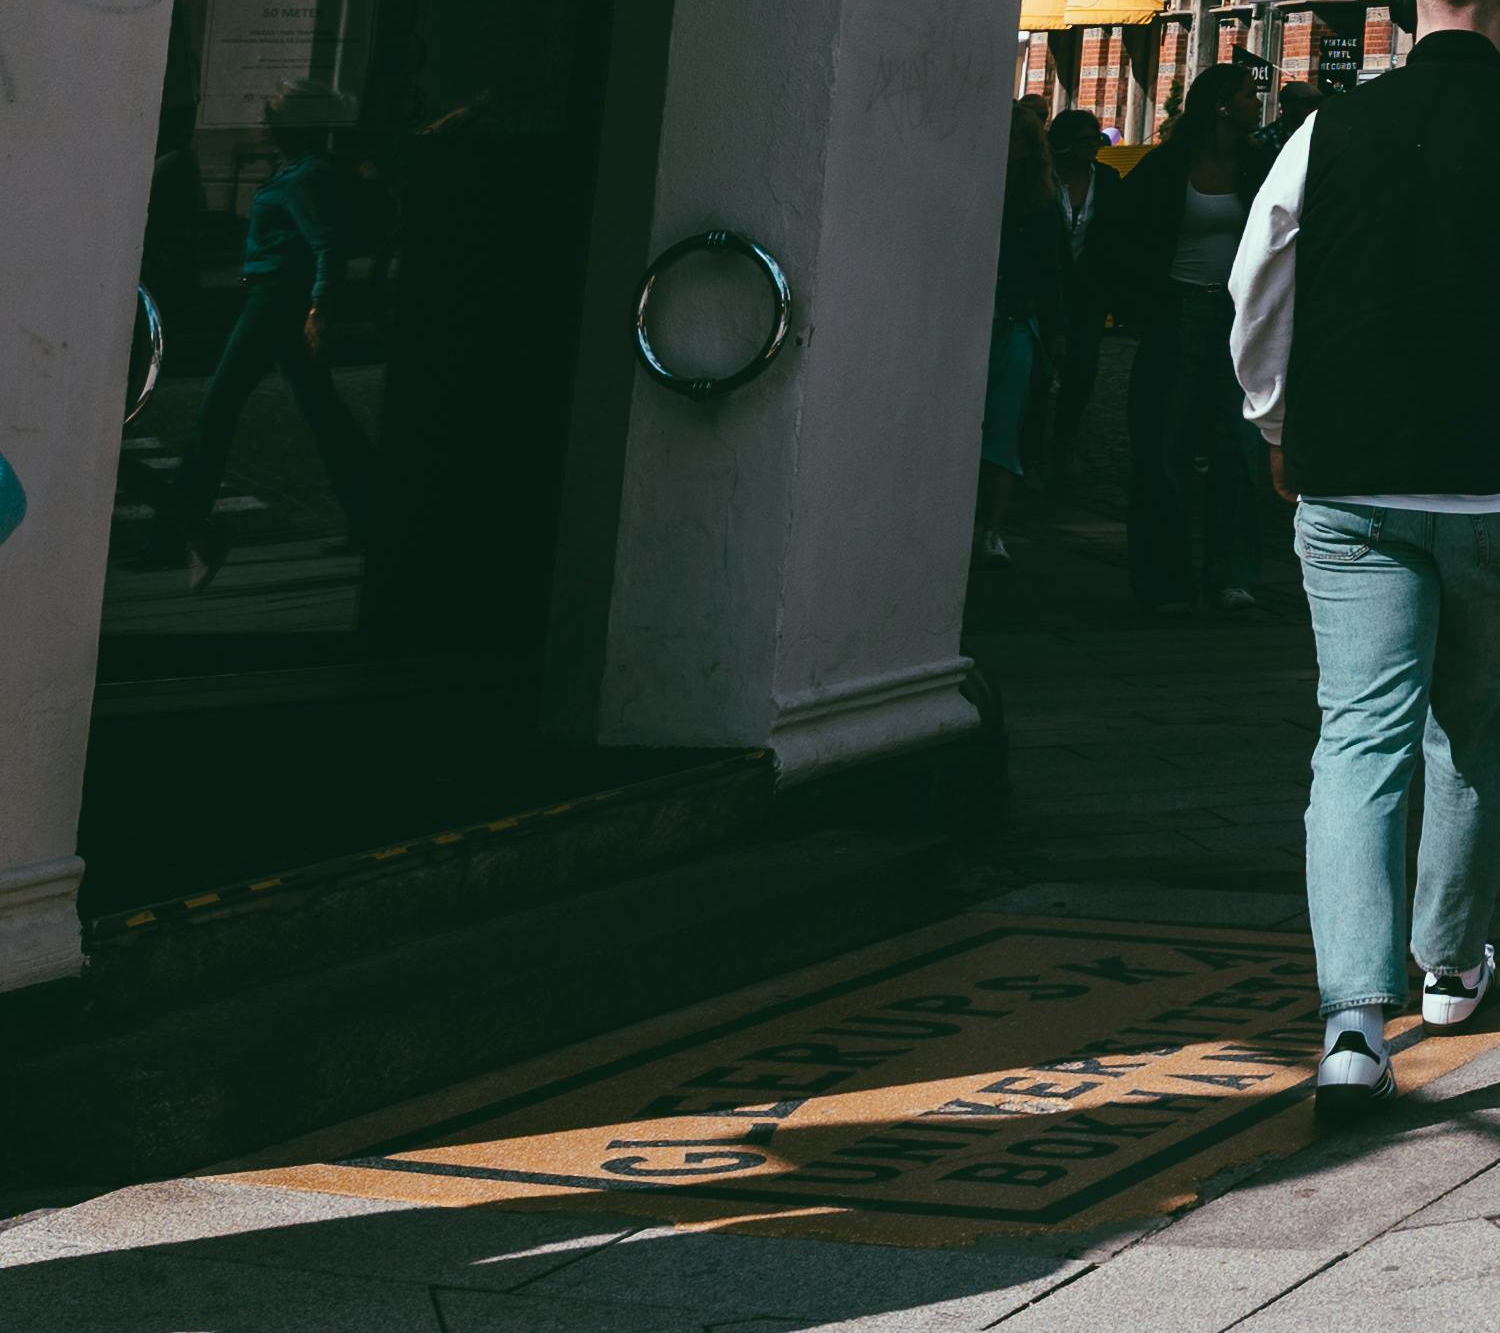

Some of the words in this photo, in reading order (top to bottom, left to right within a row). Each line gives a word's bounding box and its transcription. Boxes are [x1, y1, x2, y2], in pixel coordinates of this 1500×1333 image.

[1323, 38, 1358, 47] VINTAGE
[1328, 50, 1352, 59] VINYL
[1320, 62, 1358, 71] RECORDS
[599, 945, 1282, 1178] GLEERUPSKA
[936, 1009, 1327, 1189] BOKHAND
